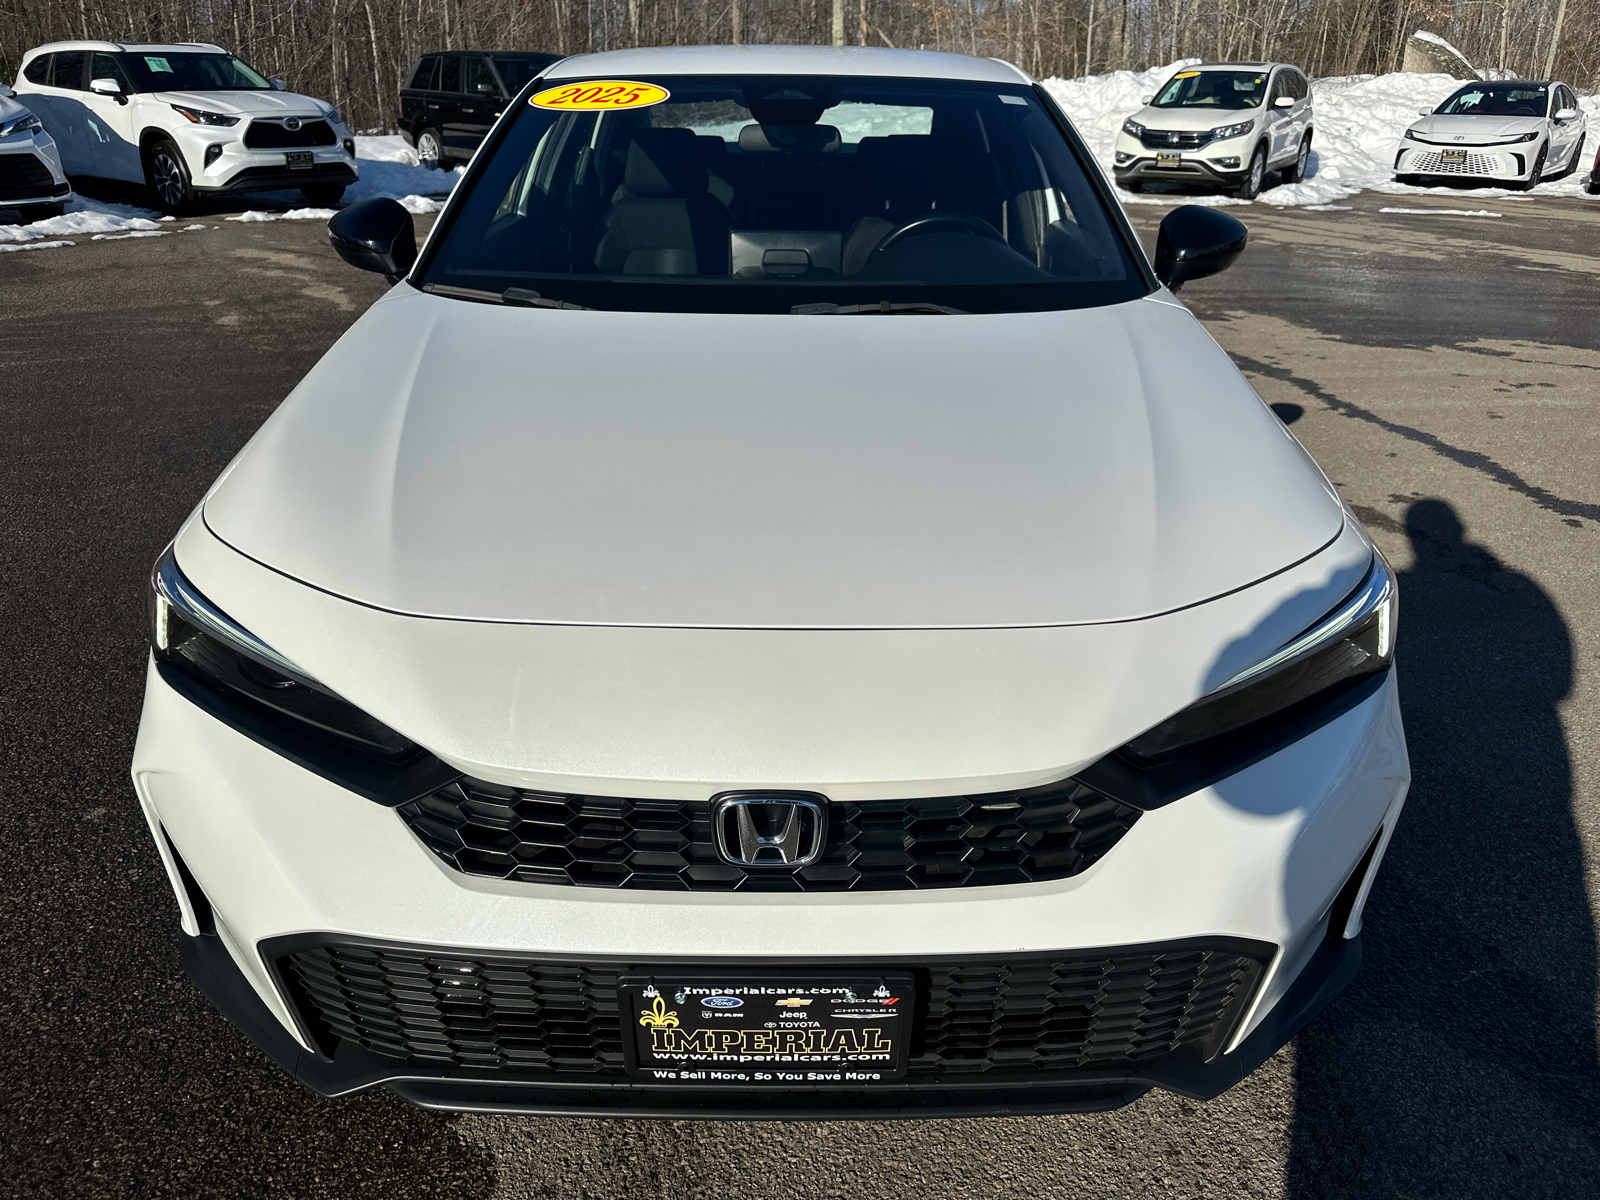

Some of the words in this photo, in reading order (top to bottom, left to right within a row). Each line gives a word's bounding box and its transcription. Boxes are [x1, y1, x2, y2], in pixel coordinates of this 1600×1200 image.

[546, 86, 651, 105] 2025
[684, 986, 850, 995] Imperialcars.com
[779, 1011, 807, 1019] Jeep
[651, 1028, 891, 1054] IMPERIAL
[652, 1053, 890, 1062] www.imperialcars.com
[653, 1070, 677, 1079] We
[680, 1071, 706, 1079] Sell
[710, 1072, 750, 1081] More,
[754, 1072, 773, 1080] So
[776, 1072, 803, 1080] You
[806, 1072, 841, 1080] Save
[845, 1072, 881, 1080] More
